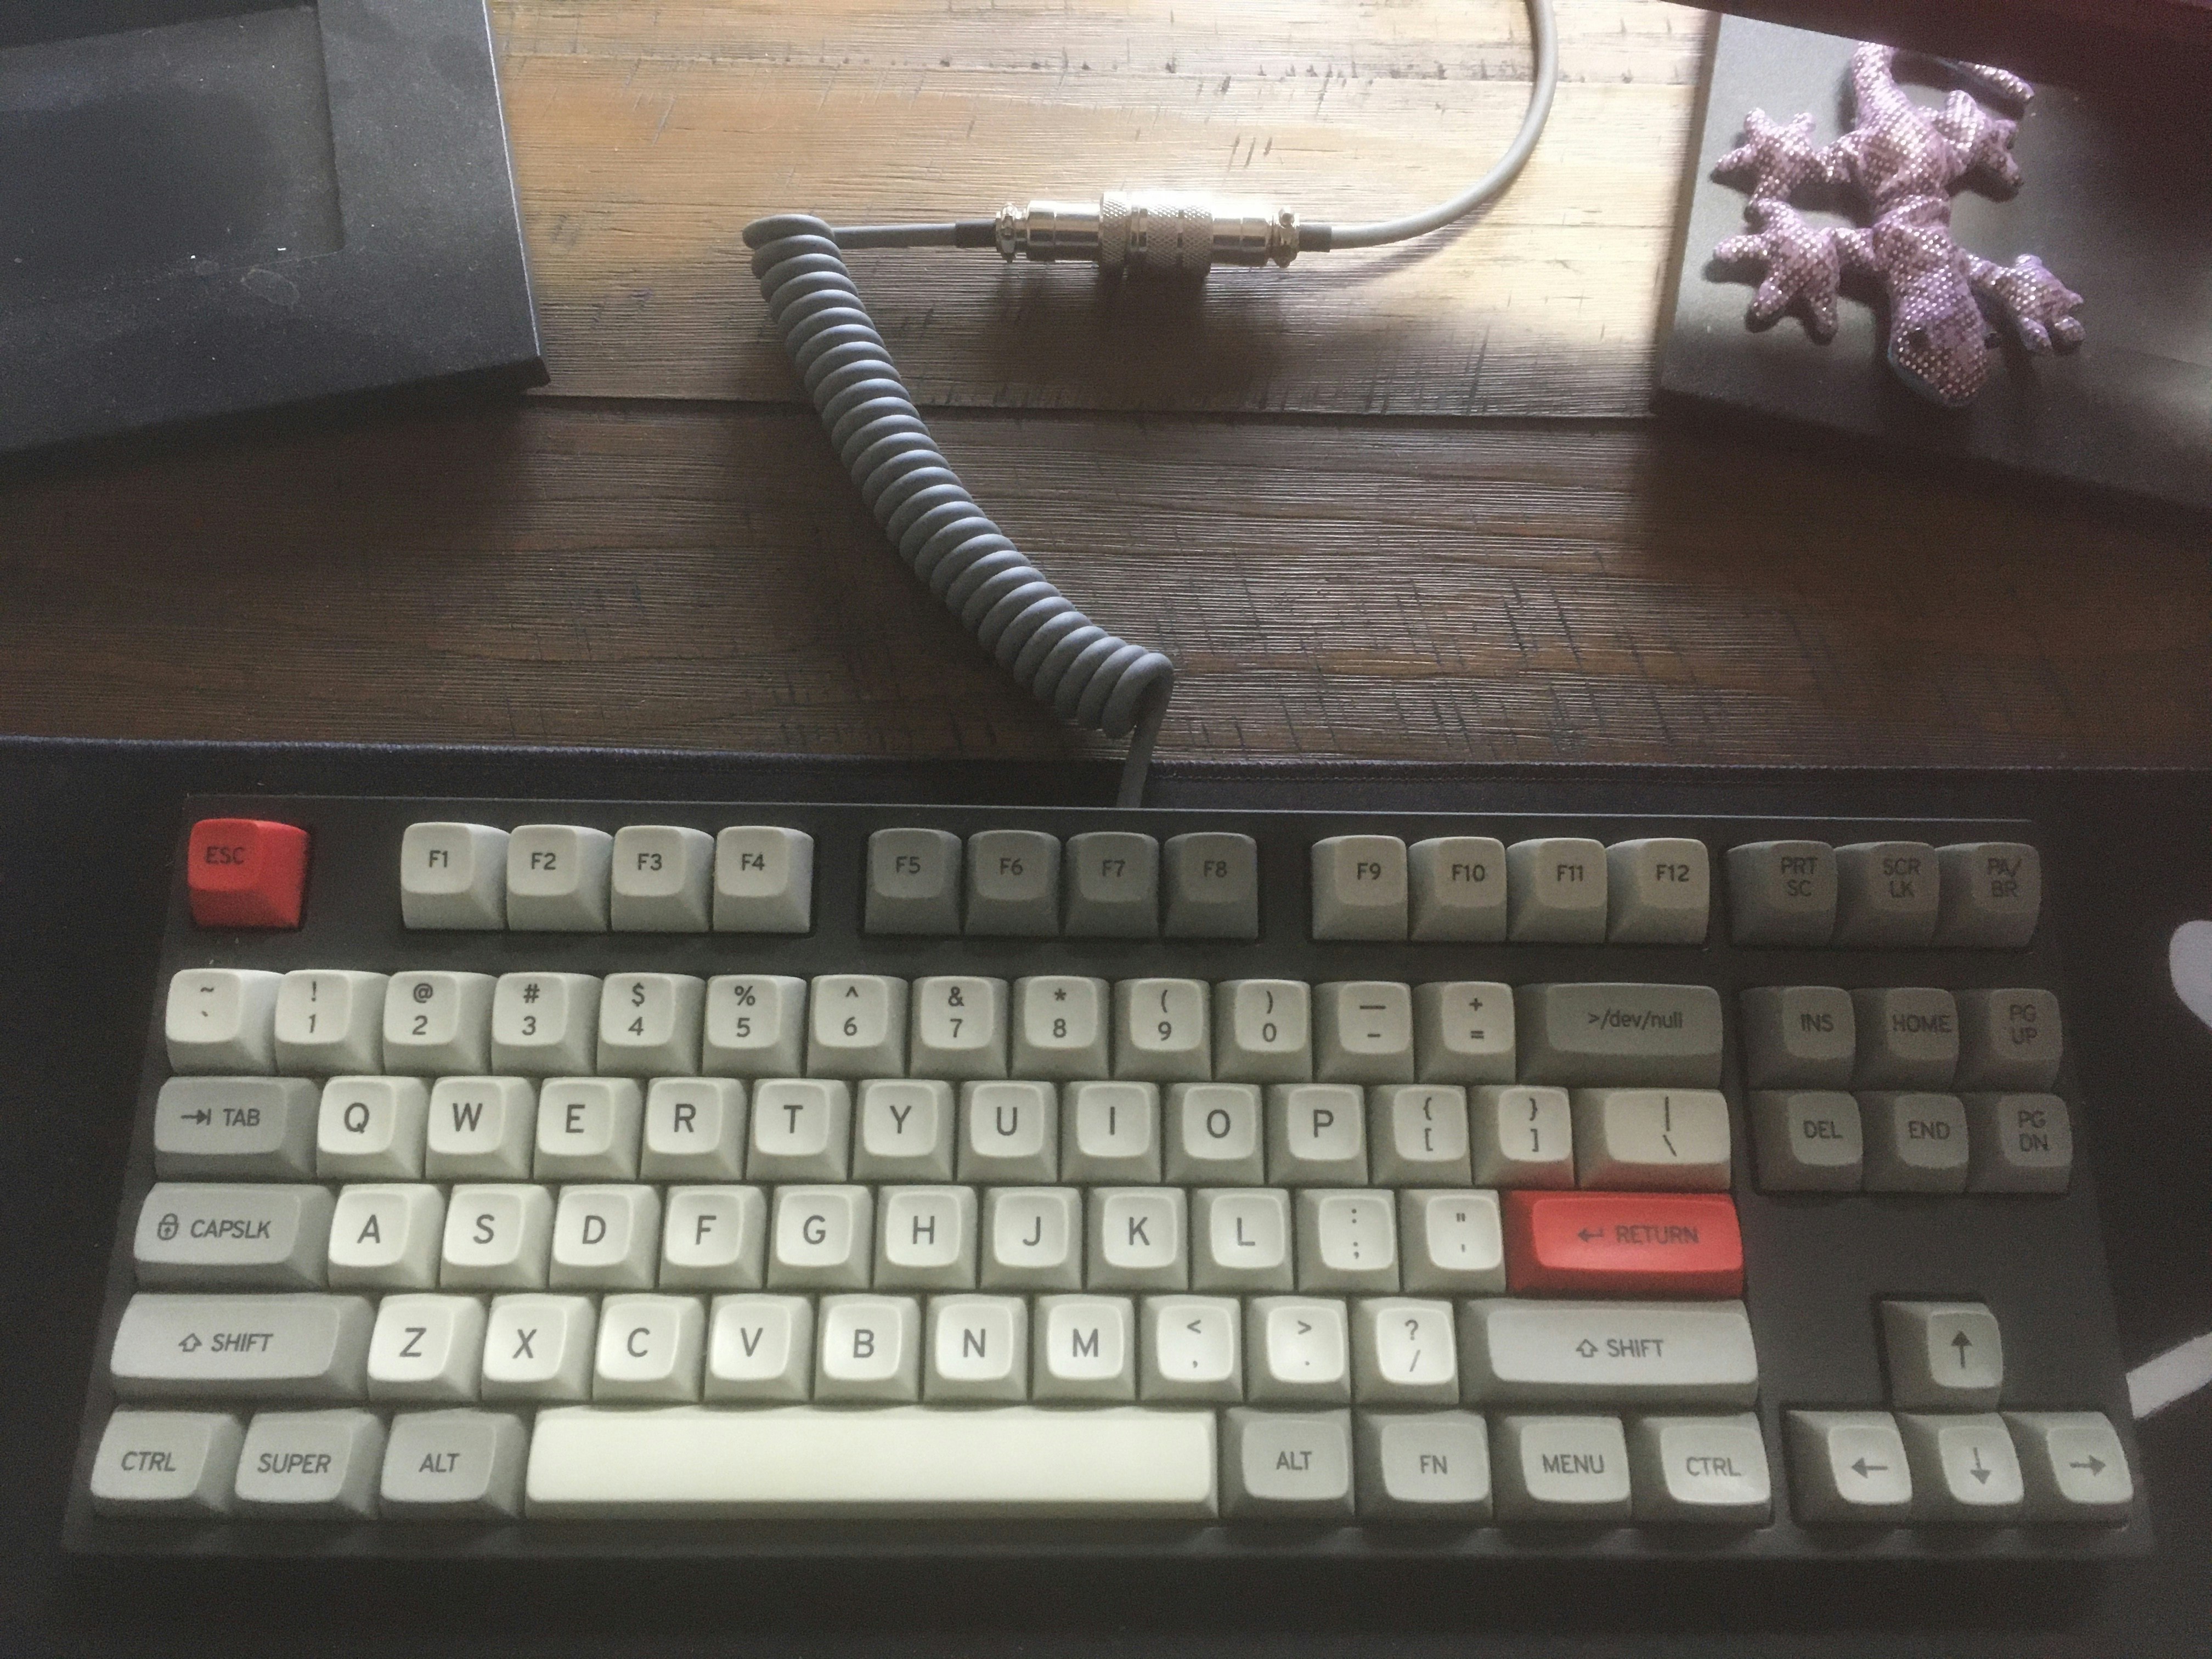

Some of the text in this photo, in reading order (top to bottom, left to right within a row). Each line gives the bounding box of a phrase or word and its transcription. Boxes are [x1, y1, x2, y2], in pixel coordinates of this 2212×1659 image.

[204, 844, 246, 866] ESC
[428, 849, 449, 868] F1
[530, 851, 557, 871] F2
[636, 852, 663, 872] F3
[741, 852, 766, 872] F4
[895, 855, 922, 876] F5
[1780, 855, 1819, 876] PRT
[999, 856, 1024, 877] F6
[1101, 858, 1126, 878] F7
[1203, 859, 1229, 879] F8
[1356, 861, 1382, 881] F9
[1451, 863, 1487, 883] F10
[1556, 863, 1584, 883] F11
[1655, 863, 1690, 883] F12
[1882, 856, 1922, 878] SCR
[1786, 878, 1813, 898] SC
[1887, 877, 1915, 899] LK
[1990, 879, 2019, 899] BR
[308, 1013, 317, 1034] 1
[1587, 1007, 1684, 1031] >/dev/null
[1799, 1012, 1835, 1033] INS
[1891, 1013, 1953, 1034] HOME
[2008, 1003, 2038, 1024] PG
[411, 1014, 428, 1036] 2
[521, 1014, 537, 1036] 3
[627, 1015, 645, 1037] 4
[736, 1016, 752, 1039] 5
[843, 1015, 858, 1037] 6
[949, 1017, 964, 1039] 7
[1052, 1017, 1068, 1039] 8
[1157, 1020, 1173, 1042] 9
[1261, 1021, 1278, 1043] 0
[2009, 1025, 2039, 1046] UP
[222, 1107, 261, 1127] TAB
[343, 1101, 370, 1135] Q
[452, 1102, 484, 1133] W
[565, 1103, 586, 1134] E
[673, 1102, 697, 1133] R
[782, 1104, 804, 1135] T
[889, 1104, 912, 1135] Y
[995, 1105, 1018, 1137] U
[1108, 1105, 1116, 1136] I
[1205, 1108, 1232, 1139] O
[1312, 1108, 1335, 1139] P
[2017, 1109, 2047, 1130] PG
[1802, 1119, 1844, 1140] DEL
[1907, 1119, 1951, 1141] END
[2018, 1132, 2051, 1153] DN
[189, 1218, 272, 1240] CAPSLK
[356, 1214, 381, 1244] A
[472, 1213, 495, 1245] S
[581, 1214, 607, 1245] D
[695, 1214, 718, 1246] F
[802, 1214, 827, 1245] G
[912, 1215, 936, 1245] H
[1022, 1215, 1042, 1247] J
[1128, 1216, 1151, 1246] K
[1235, 1216, 1256, 1247] L
[1614, 1223, 1700, 1245] RETURN
[210, 1332, 275, 1353] SHIFT
[398, 1326, 427, 1358] Z
[512, 1328, 538, 1359] X
[626, 1327, 651, 1358] C
[740, 1327, 764, 1358] V
[852, 1328, 875, 1359] B
[962, 1328, 987, 1358] N
[1071, 1328, 1099, 1358] M
[1605, 1338, 1664, 1358] SHIFT
[120, 1450, 177, 1473] CTRL
[256, 1452, 332, 1475] SUPER
[417, 1452, 461, 1474] ALT
[1275, 1450, 1313, 1471] ALT
[1419, 1454, 1448, 1475] FN
[1541, 1453, 1605, 1475] MENU
[1685, 1455, 1742, 1477] CTRL
